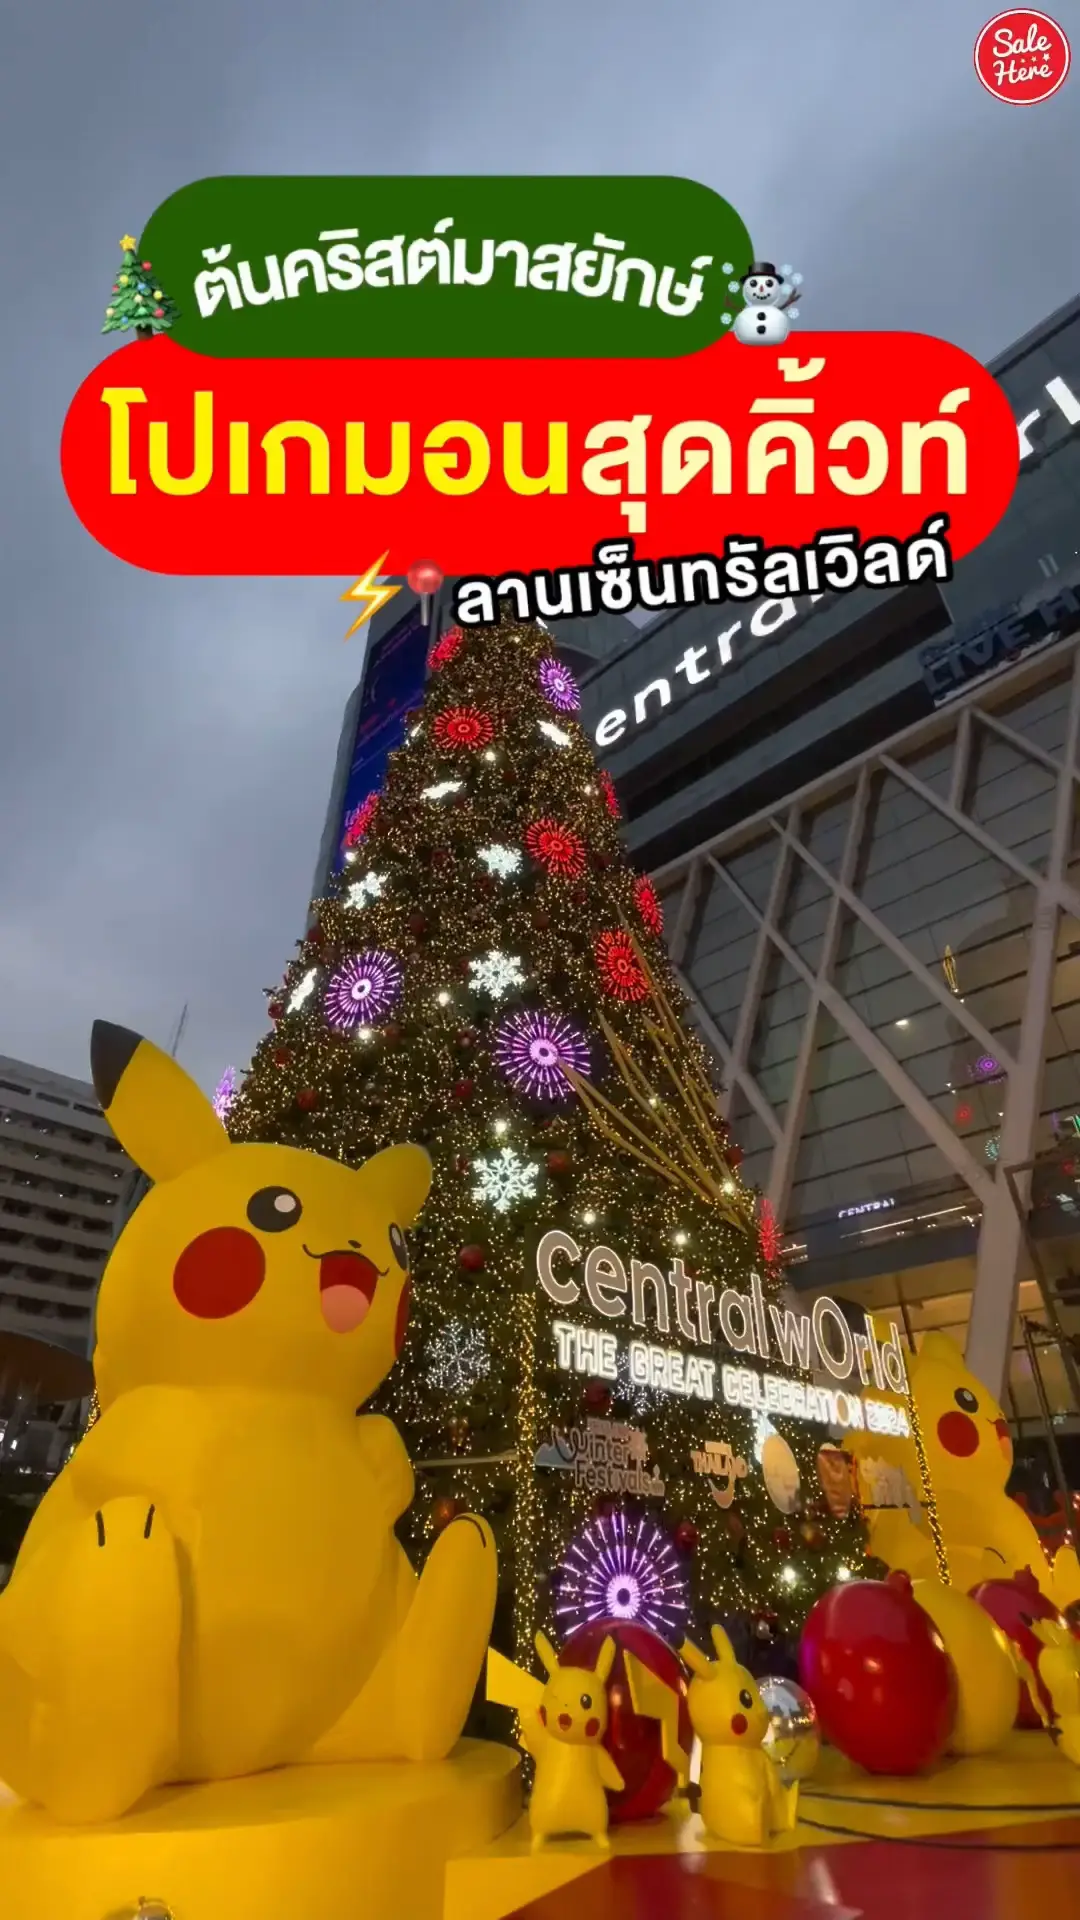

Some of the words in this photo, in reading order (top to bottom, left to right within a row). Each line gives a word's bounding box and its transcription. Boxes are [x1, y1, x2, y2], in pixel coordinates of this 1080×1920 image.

[595, 594, 824, 747] entra
[552, 1319, 618, 1380] THE
[629, 1340, 716, 1400] GREAT
[722, 1363, 864, 1429] CELEBRATION
[551, 1425, 632, 1464] Winter
[574, 1459, 652, 1495] Festivals
